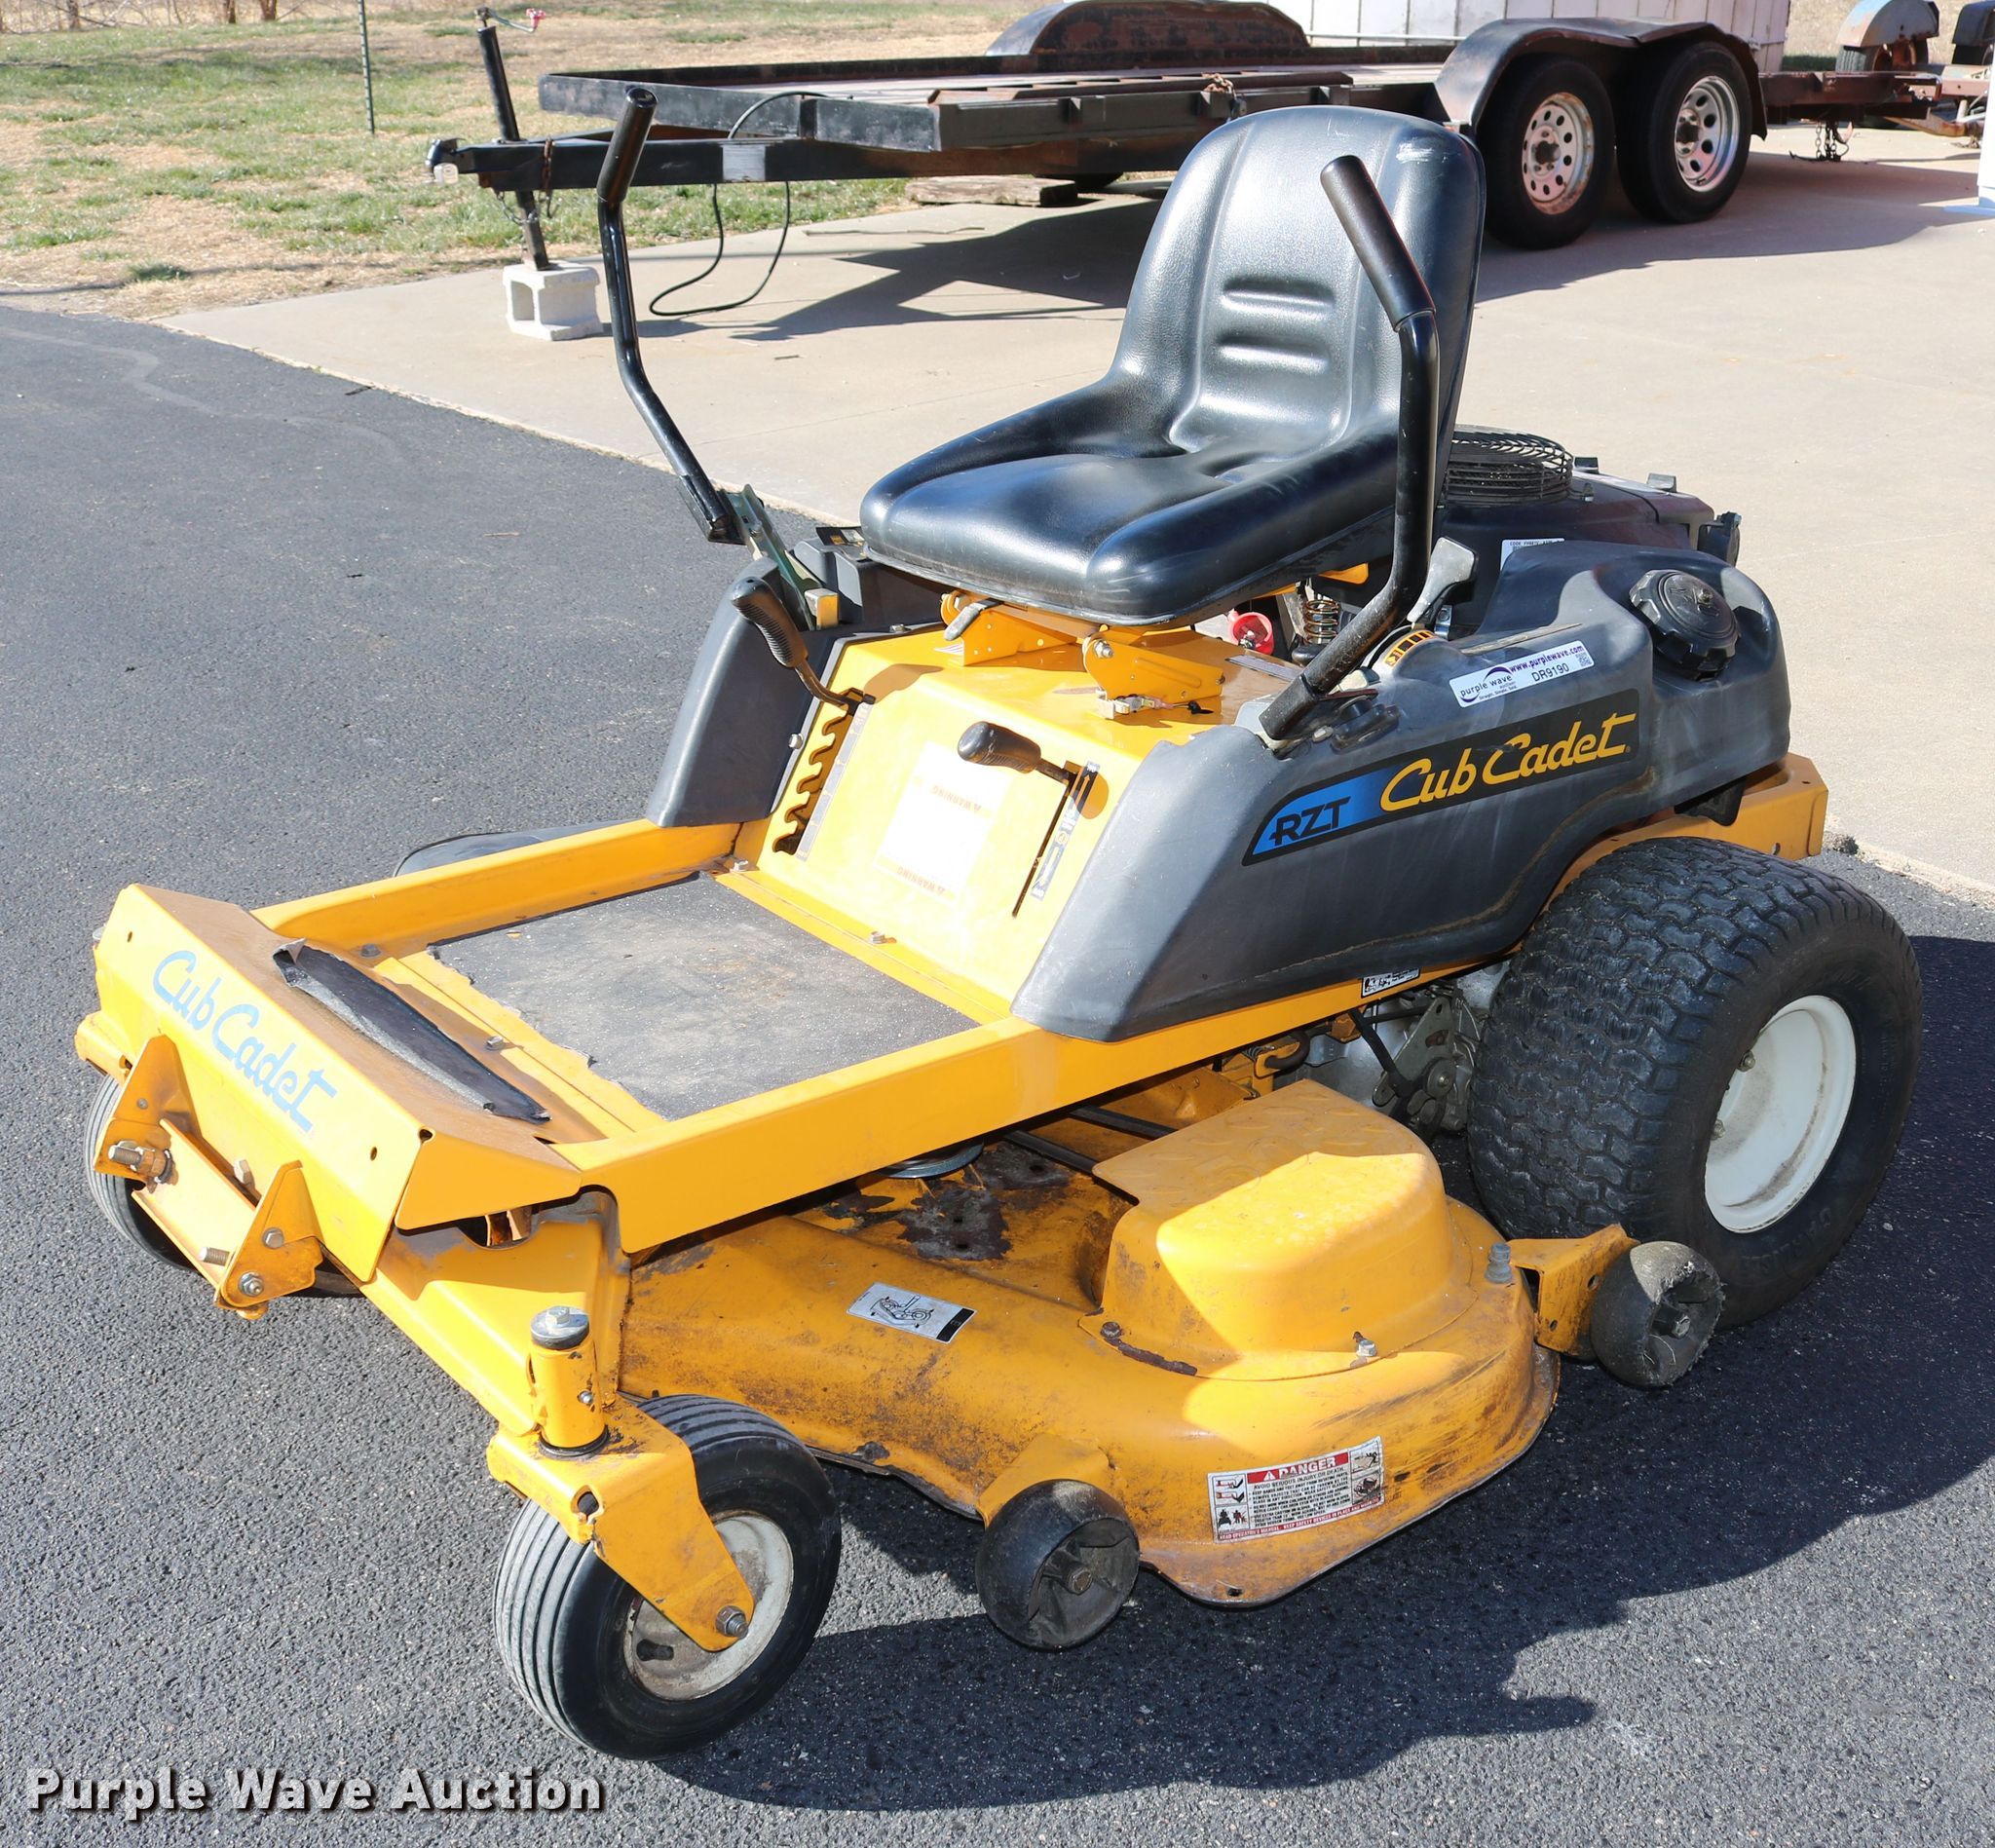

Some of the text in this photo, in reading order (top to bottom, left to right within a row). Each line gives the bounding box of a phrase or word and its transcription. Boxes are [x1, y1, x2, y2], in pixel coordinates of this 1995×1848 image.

[1511, 646, 1584, 672] www.purplewave.com
[1531, 662, 1569, 682] DR9190
[1460, 674, 1512, 698] purple wave
[1379, 712, 1637, 812] Cub Cadet
[931, 784, 973, 811] WARNING
[1269, 797, 1351, 847] RZT
[897, 866, 936, 891] WARNING
[153, 950, 338, 1133] Cub Cadet
[1278, 1456, 1336, 1480] DANGER
